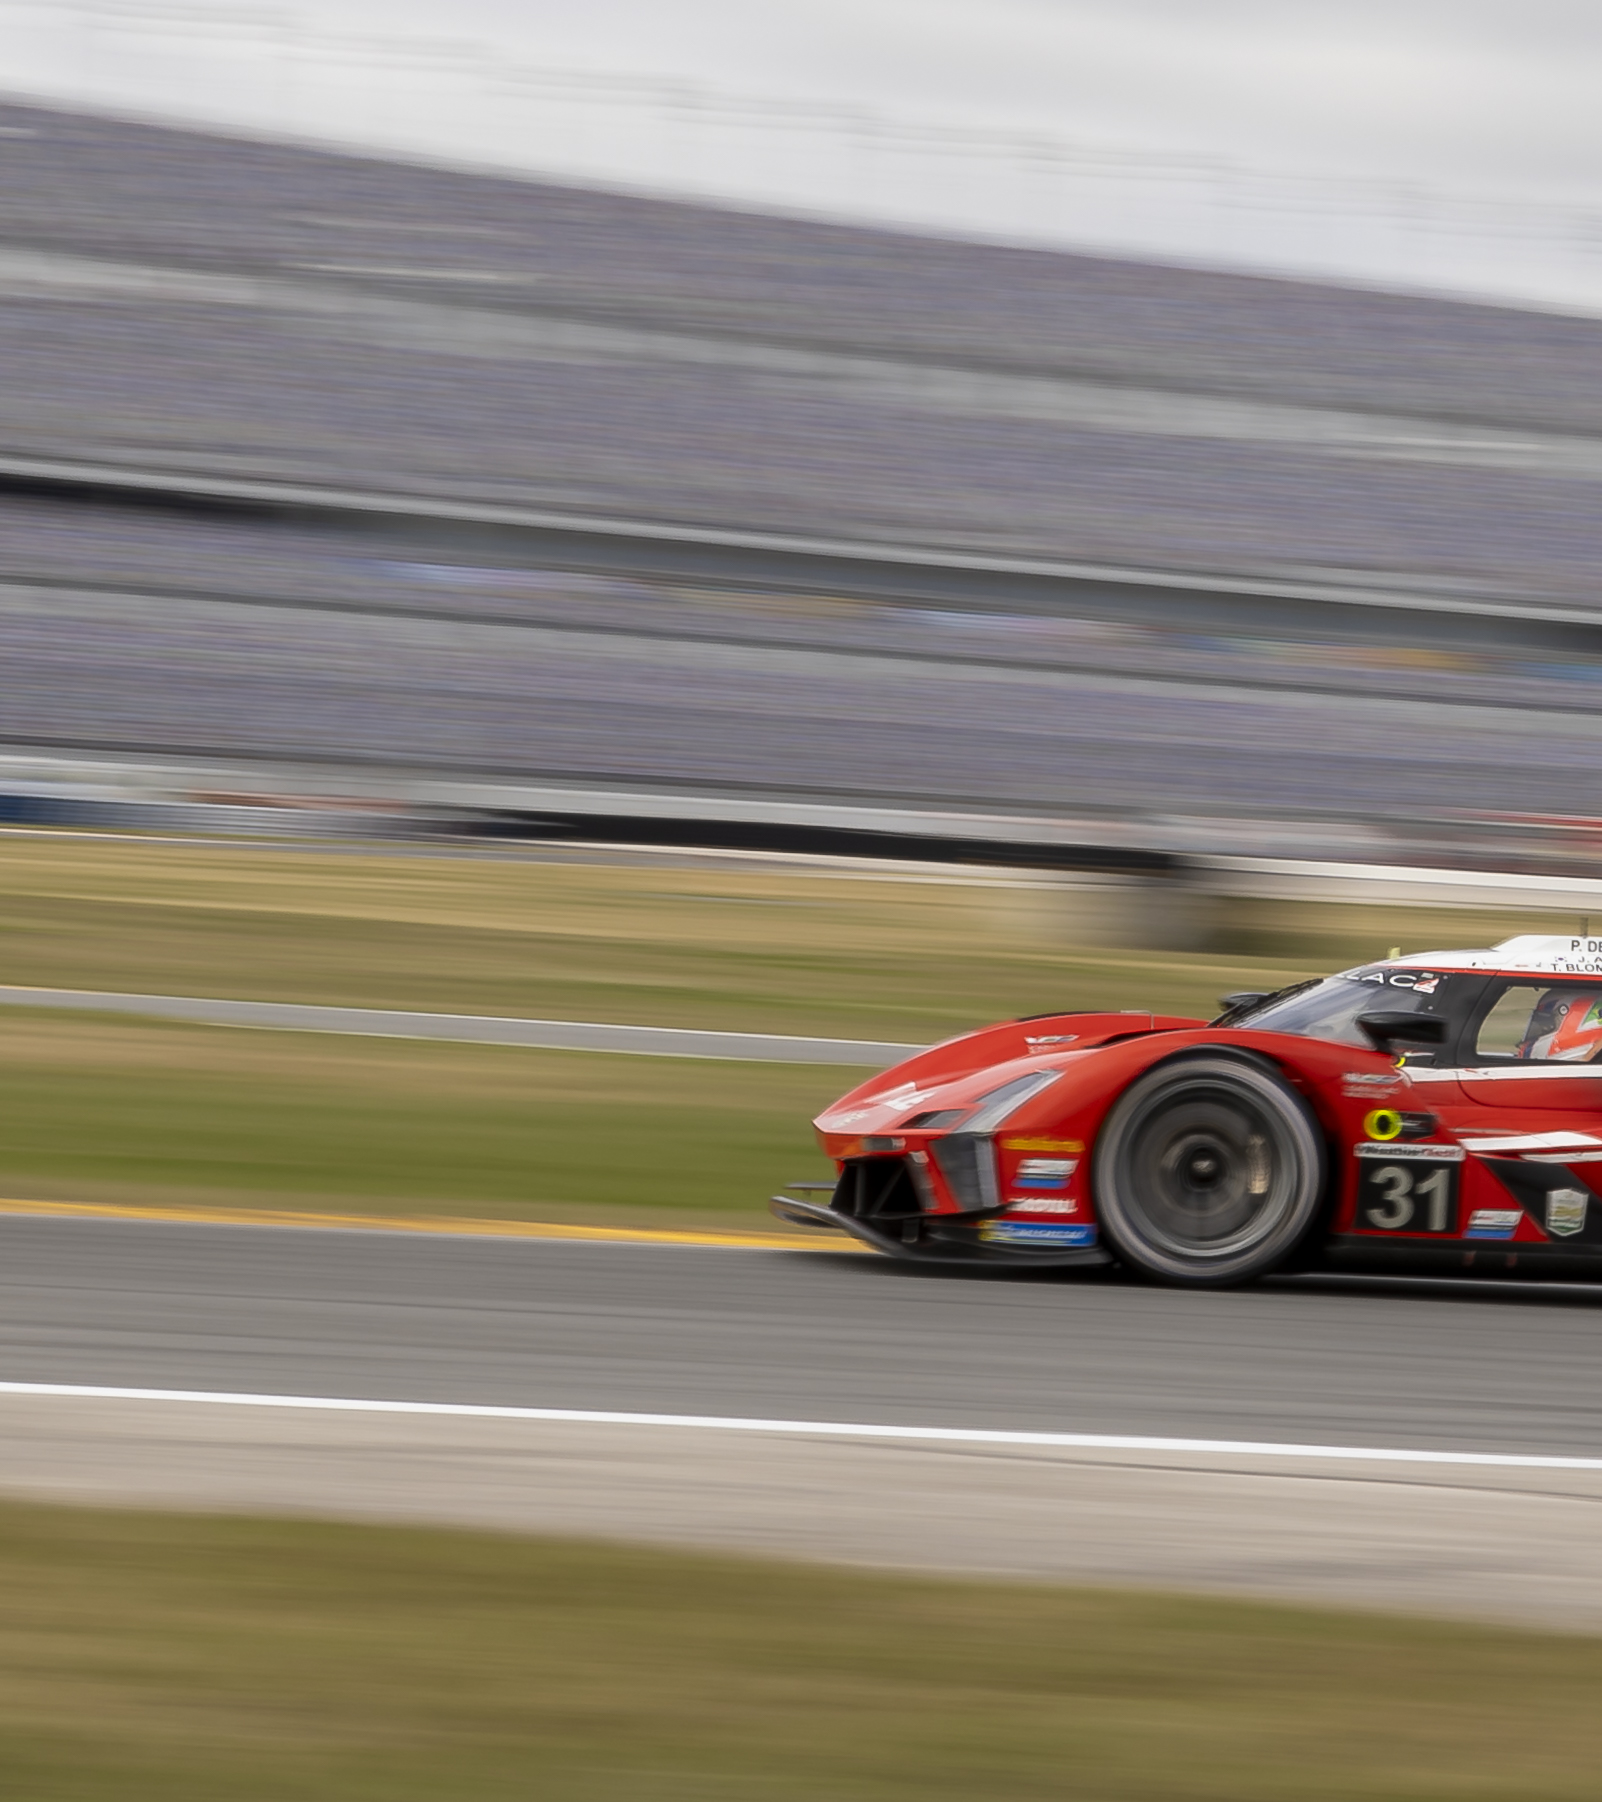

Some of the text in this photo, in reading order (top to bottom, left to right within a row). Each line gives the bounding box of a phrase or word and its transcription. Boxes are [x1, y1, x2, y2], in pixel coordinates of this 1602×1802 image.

[1571, 940, 1582, 952] P.
[1551, 963, 1562, 971] T.
[1366, 1166, 1450, 1231] 31
